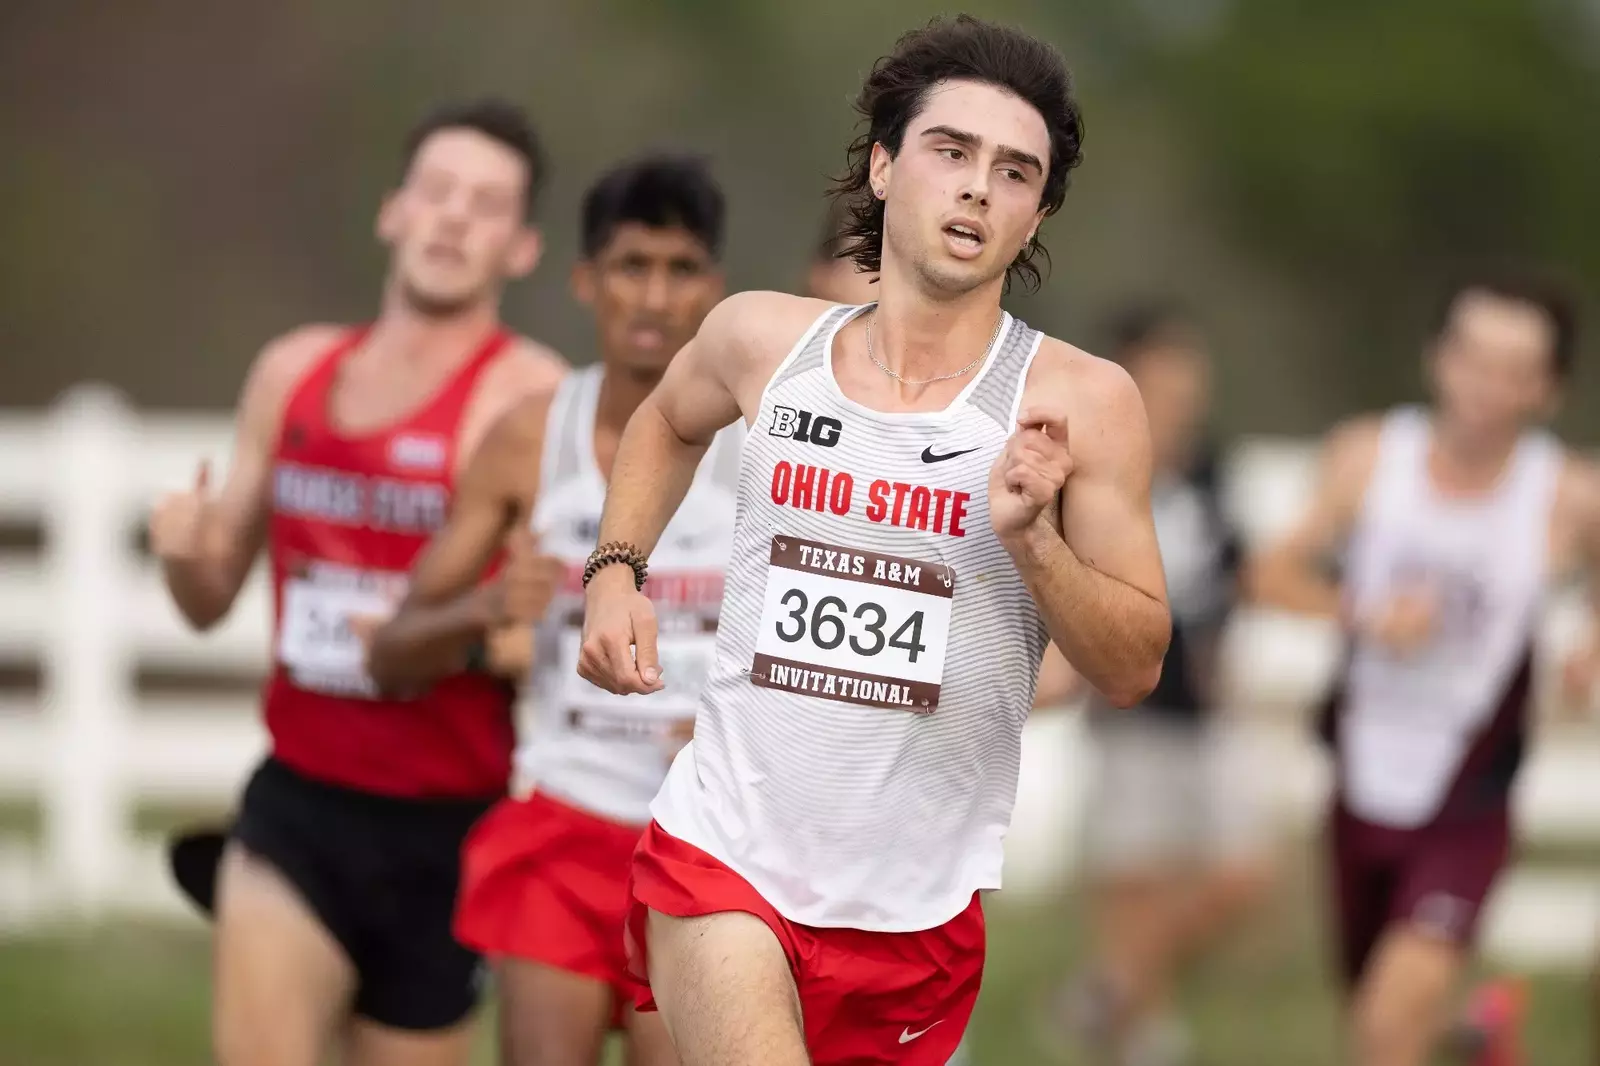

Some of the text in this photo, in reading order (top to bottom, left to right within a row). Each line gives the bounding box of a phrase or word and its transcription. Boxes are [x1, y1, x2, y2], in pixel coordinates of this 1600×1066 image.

[771, 460, 971, 537] OHIO STATE
[799, 545, 922, 586] TEXAS A&M
[775, 588, 927, 663] 3634
[769, 663, 914, 706] INVITATIONAL
